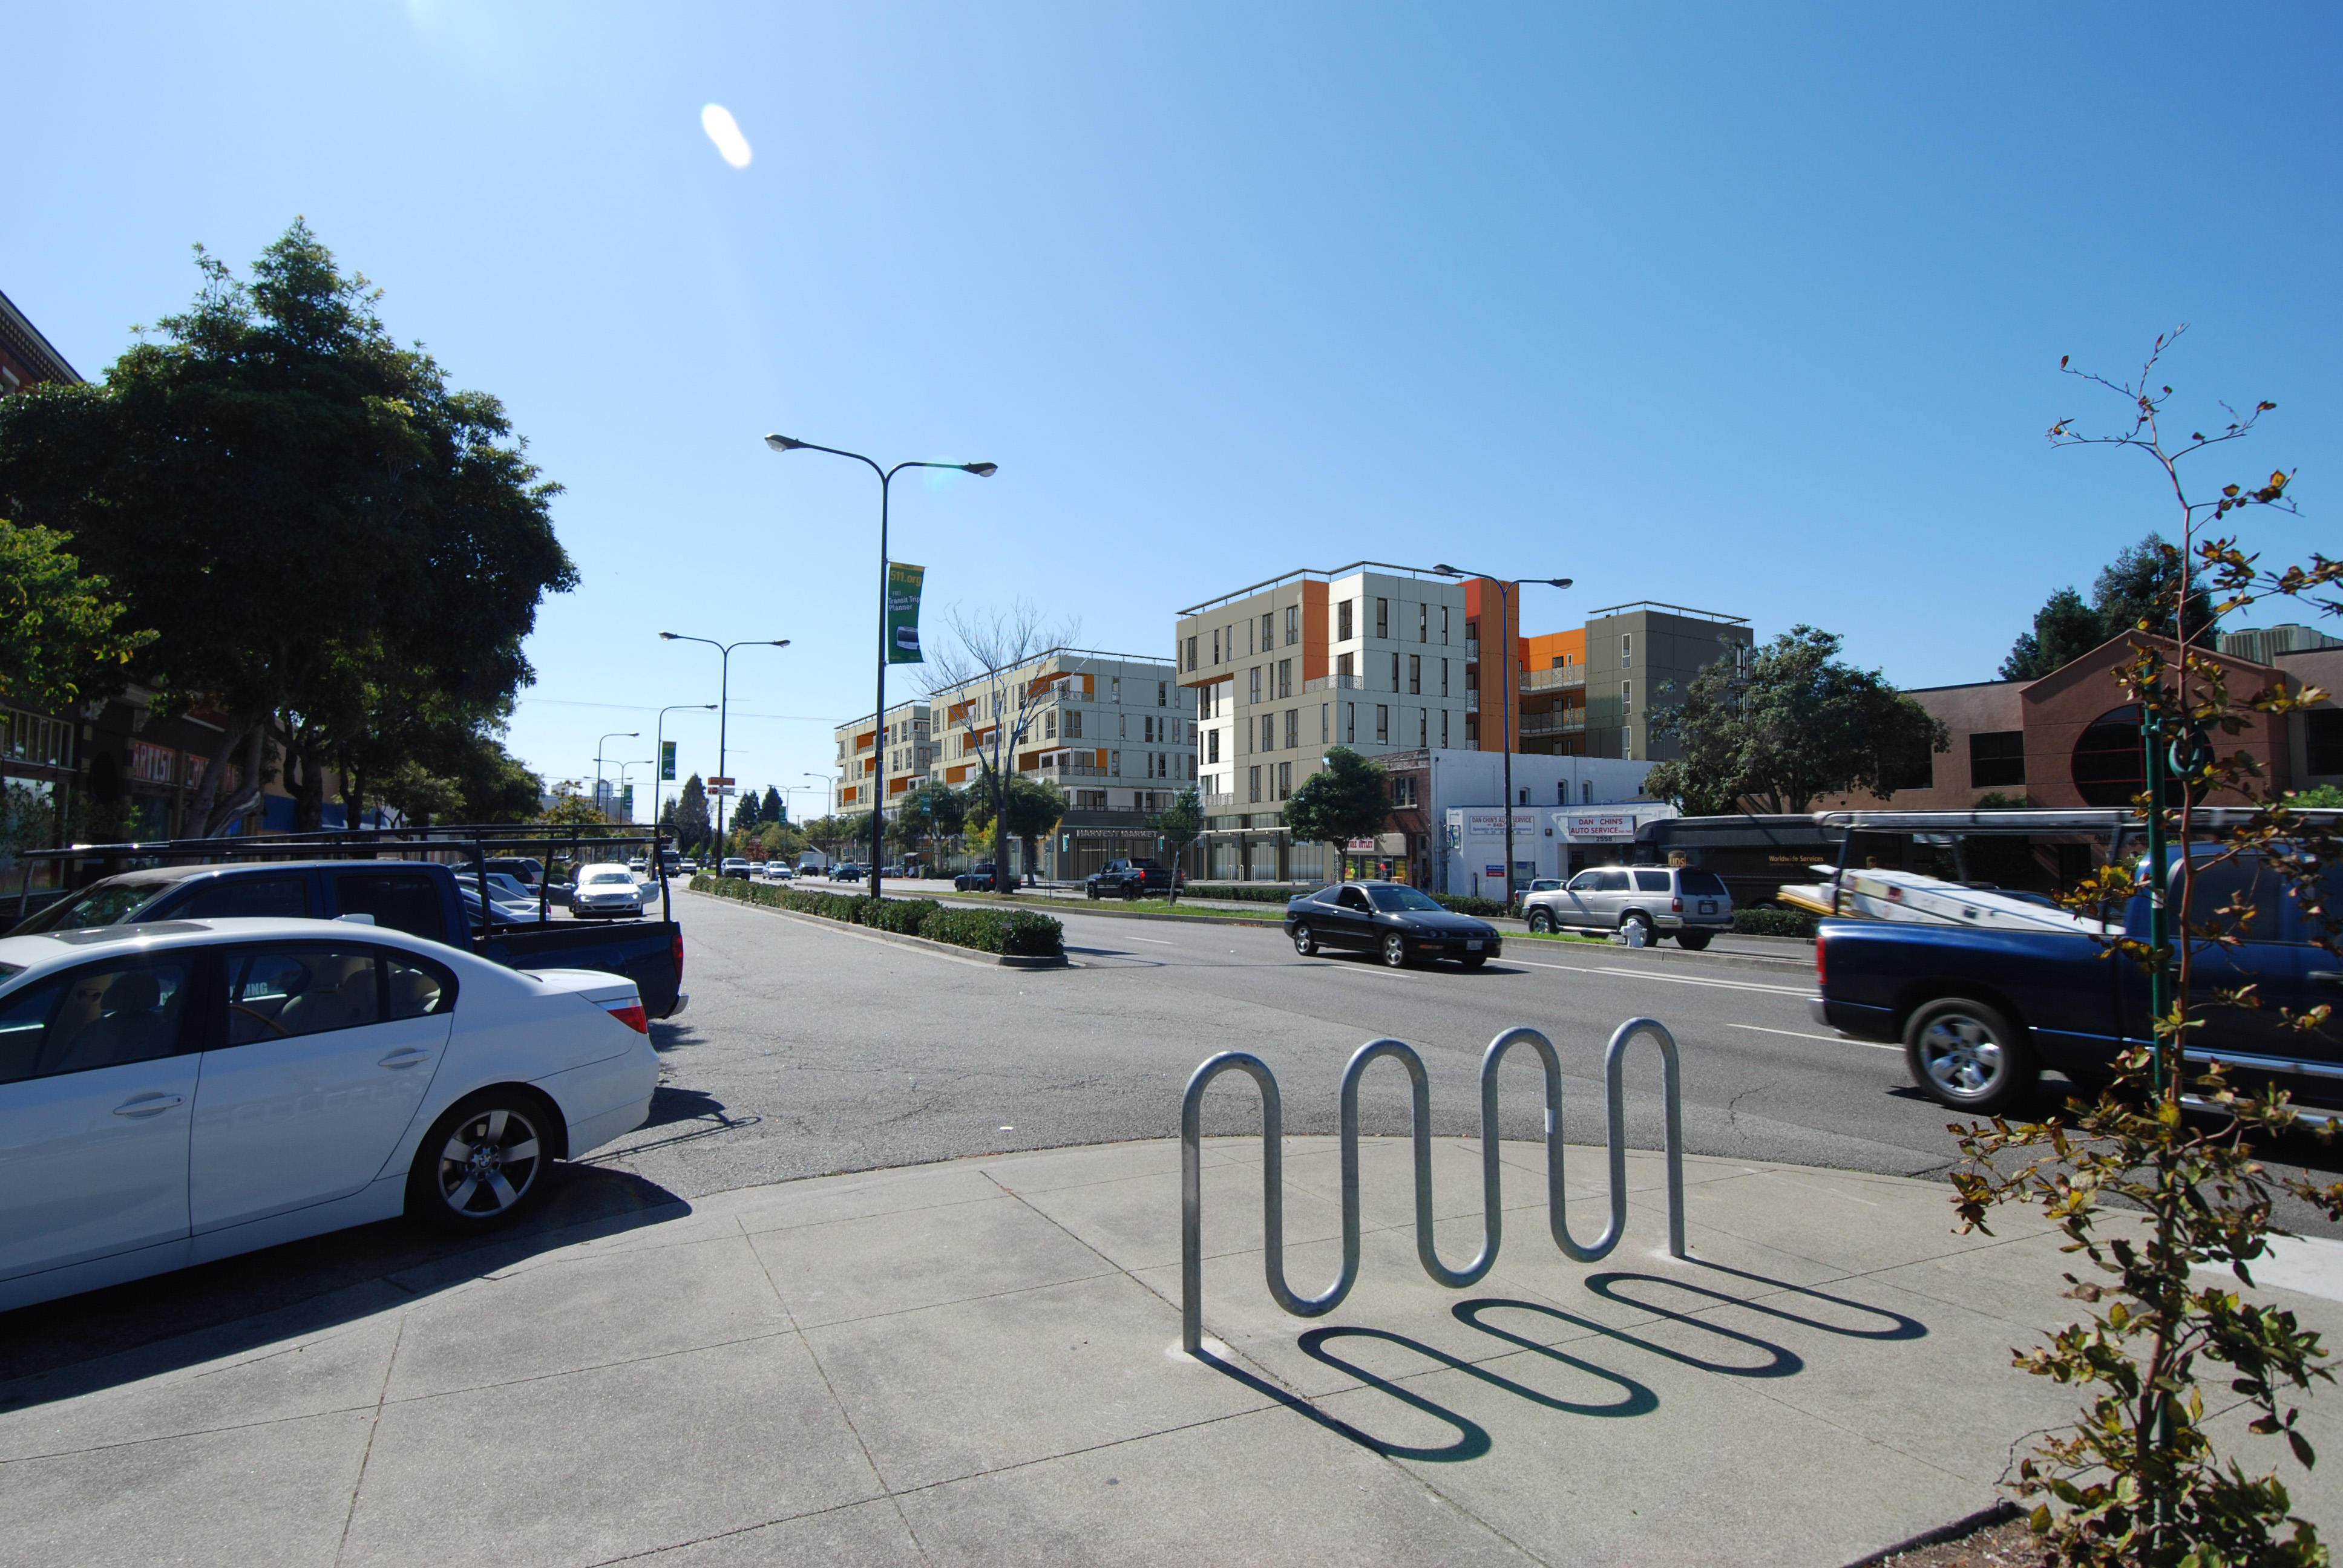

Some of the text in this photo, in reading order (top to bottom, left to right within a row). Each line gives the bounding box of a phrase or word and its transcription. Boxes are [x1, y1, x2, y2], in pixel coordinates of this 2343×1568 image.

[890, 570, 922, 587] 511.org
[909, 595, 920, 604] Trip
[133, 743, 174, 781] ARTIST
[1358, 840, 1373, 849] OUTLET
